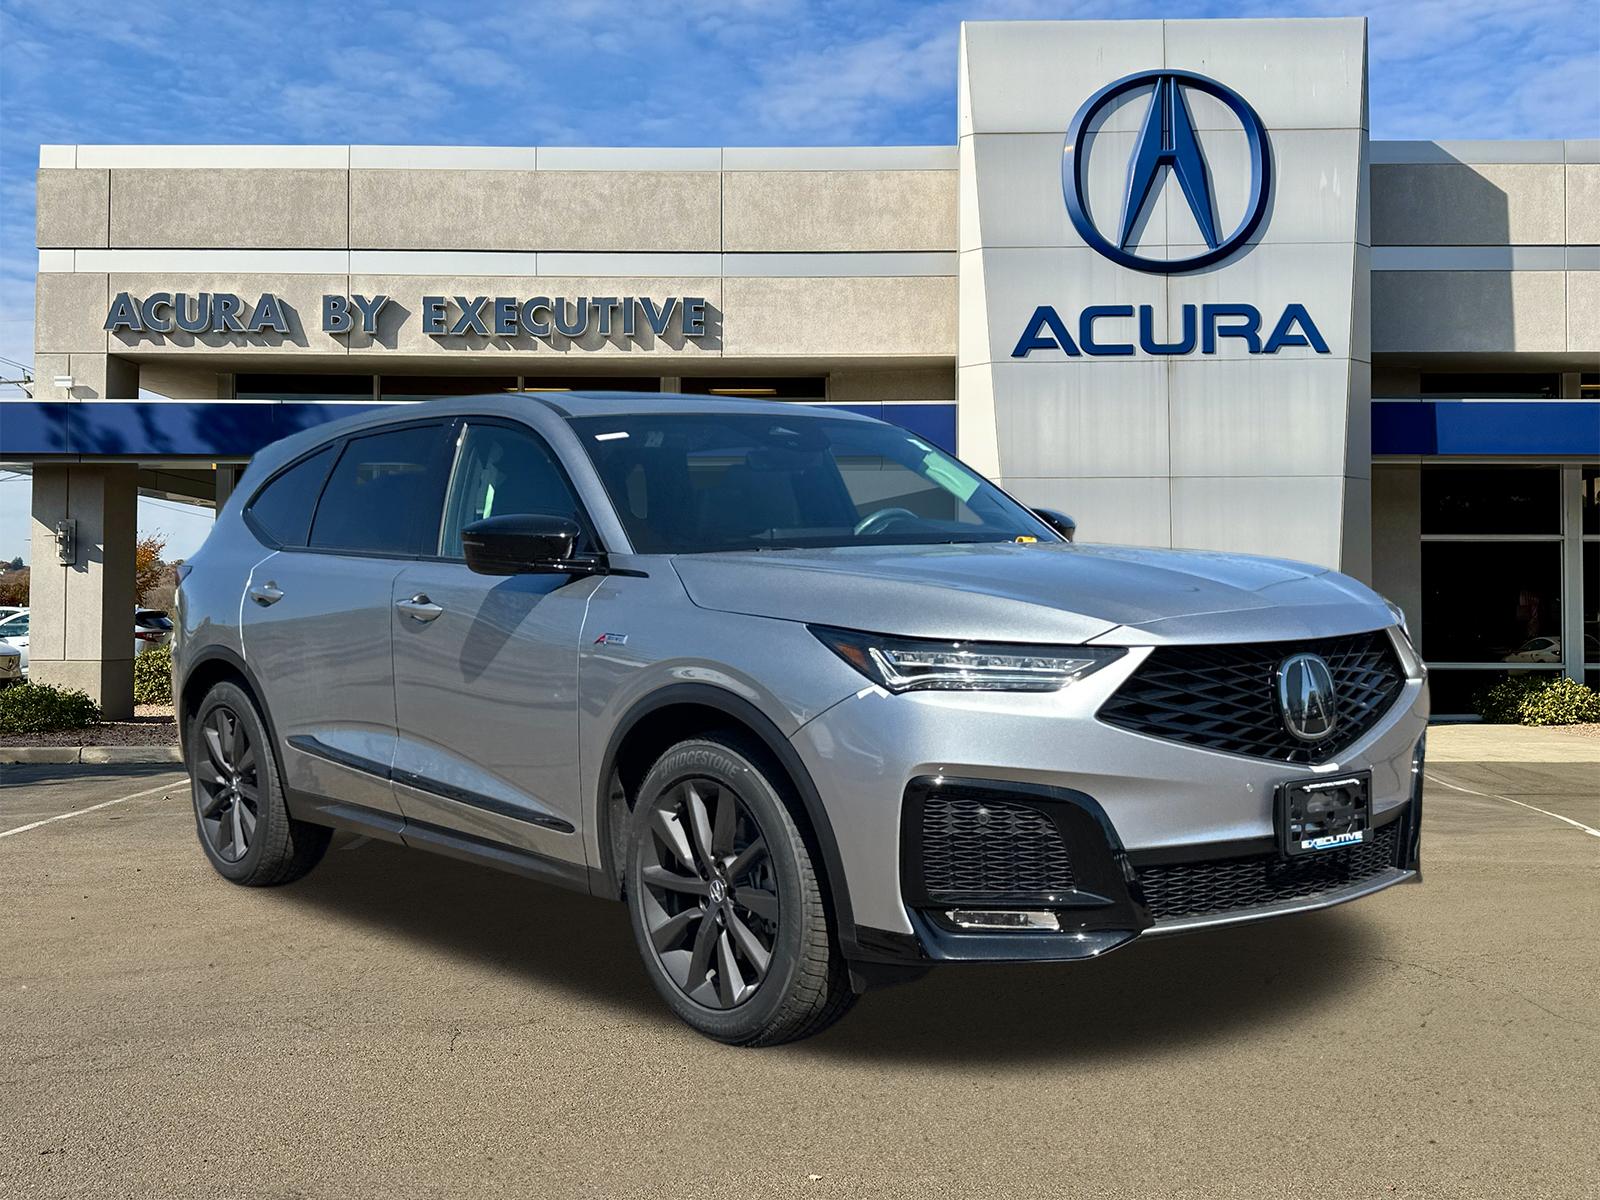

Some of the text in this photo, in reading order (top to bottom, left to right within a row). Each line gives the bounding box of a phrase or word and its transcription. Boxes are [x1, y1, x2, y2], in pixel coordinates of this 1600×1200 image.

[103, 291, 706, 337] ACURA BY EXECUTIVE
[1010, 303, 1332, 357] ACURA
[659, 750, 741, 779] BRIDGESTONE
[1301, 830, 1363, 849] EXECUTIVE
